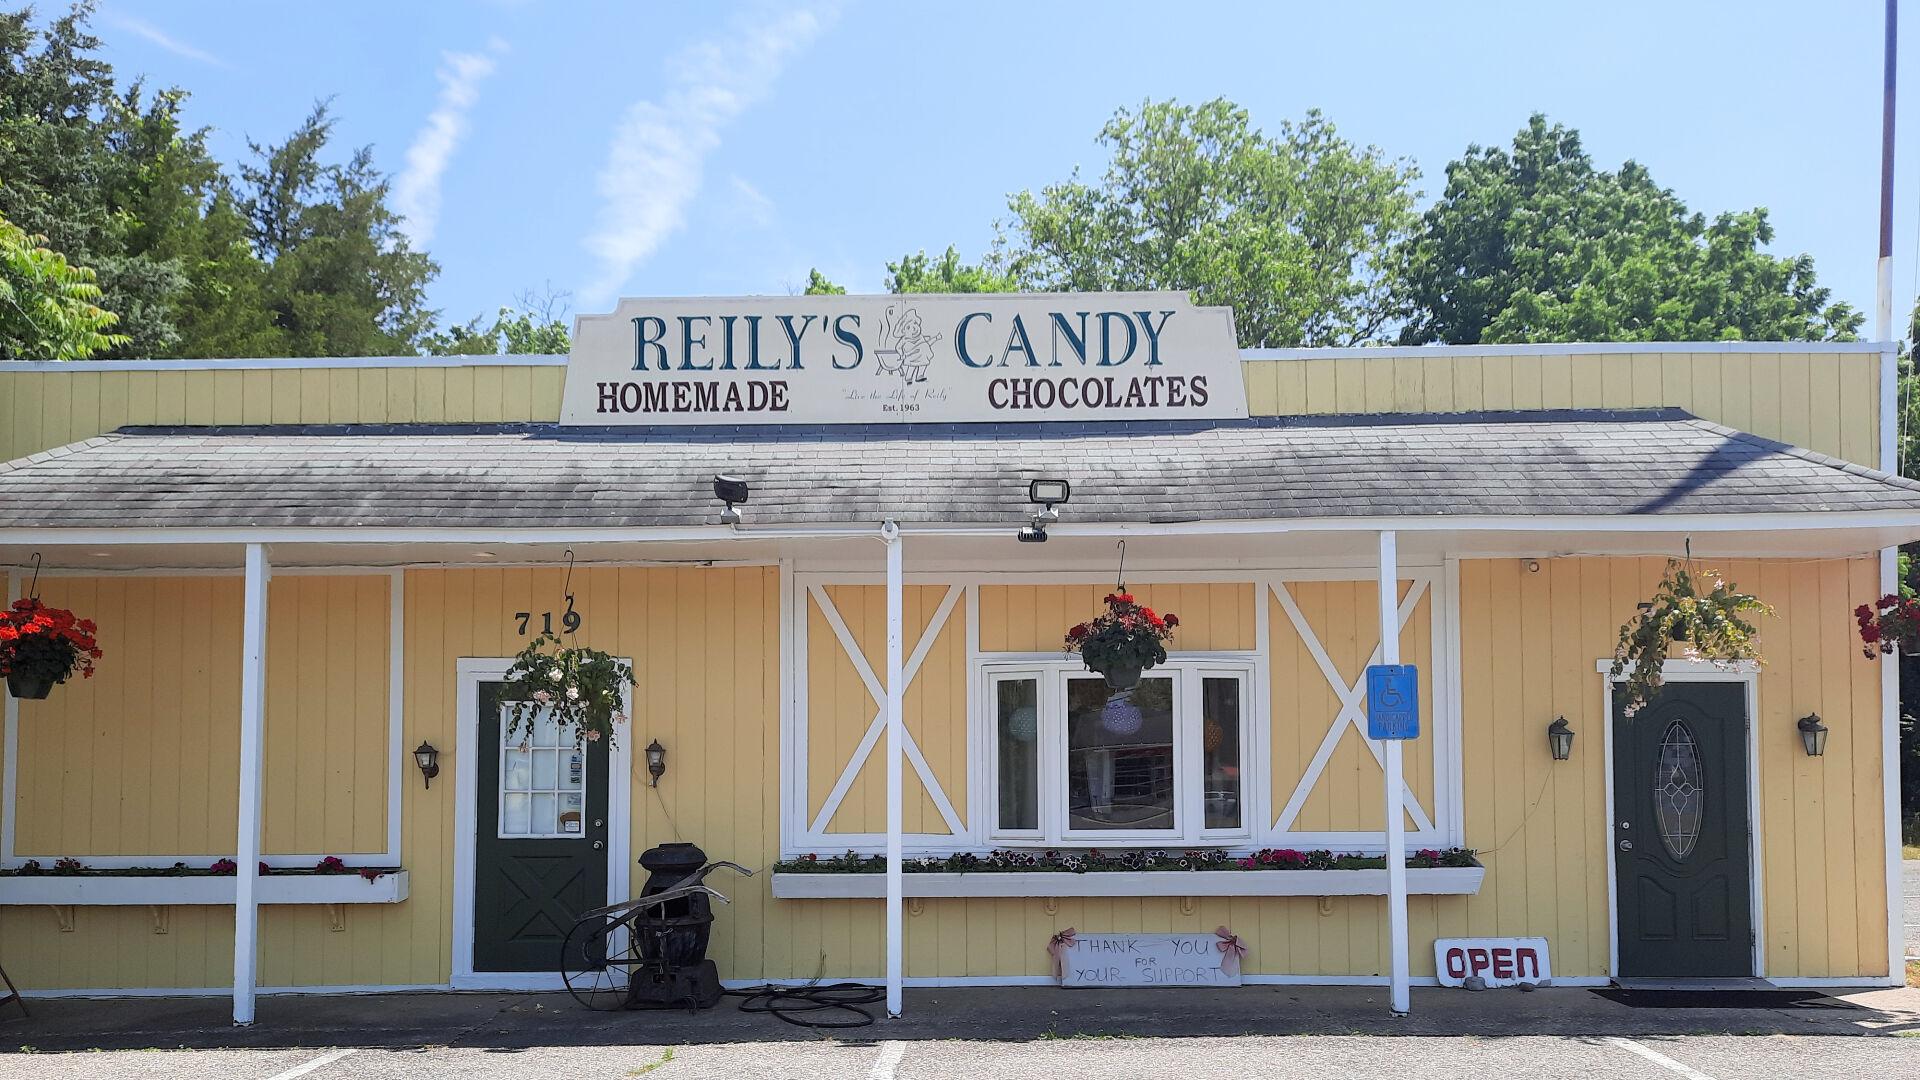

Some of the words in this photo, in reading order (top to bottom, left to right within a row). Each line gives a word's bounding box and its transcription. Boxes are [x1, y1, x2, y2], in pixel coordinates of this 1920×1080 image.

[631, 314, 864, 371] REILY'S
[954, 310, 1176, 368] CANDY
[597, 380, 790, 412] HOMEMADE
[988, 376, 1209, 409] CHOCOLATES
[882, 403, 898, 412] Est.
[900, 403, 920, 412] 1963
[514, 611, 581, 635] 719
[1076, 938, 1142, 953] THANK
[1171, 938, 1209, 955] YOU
[1135, 957, 1158, 967] FOR
[1075, 967, 1125, 983] YOUR
[1143, 966, 1221, 983] SUPPORT
